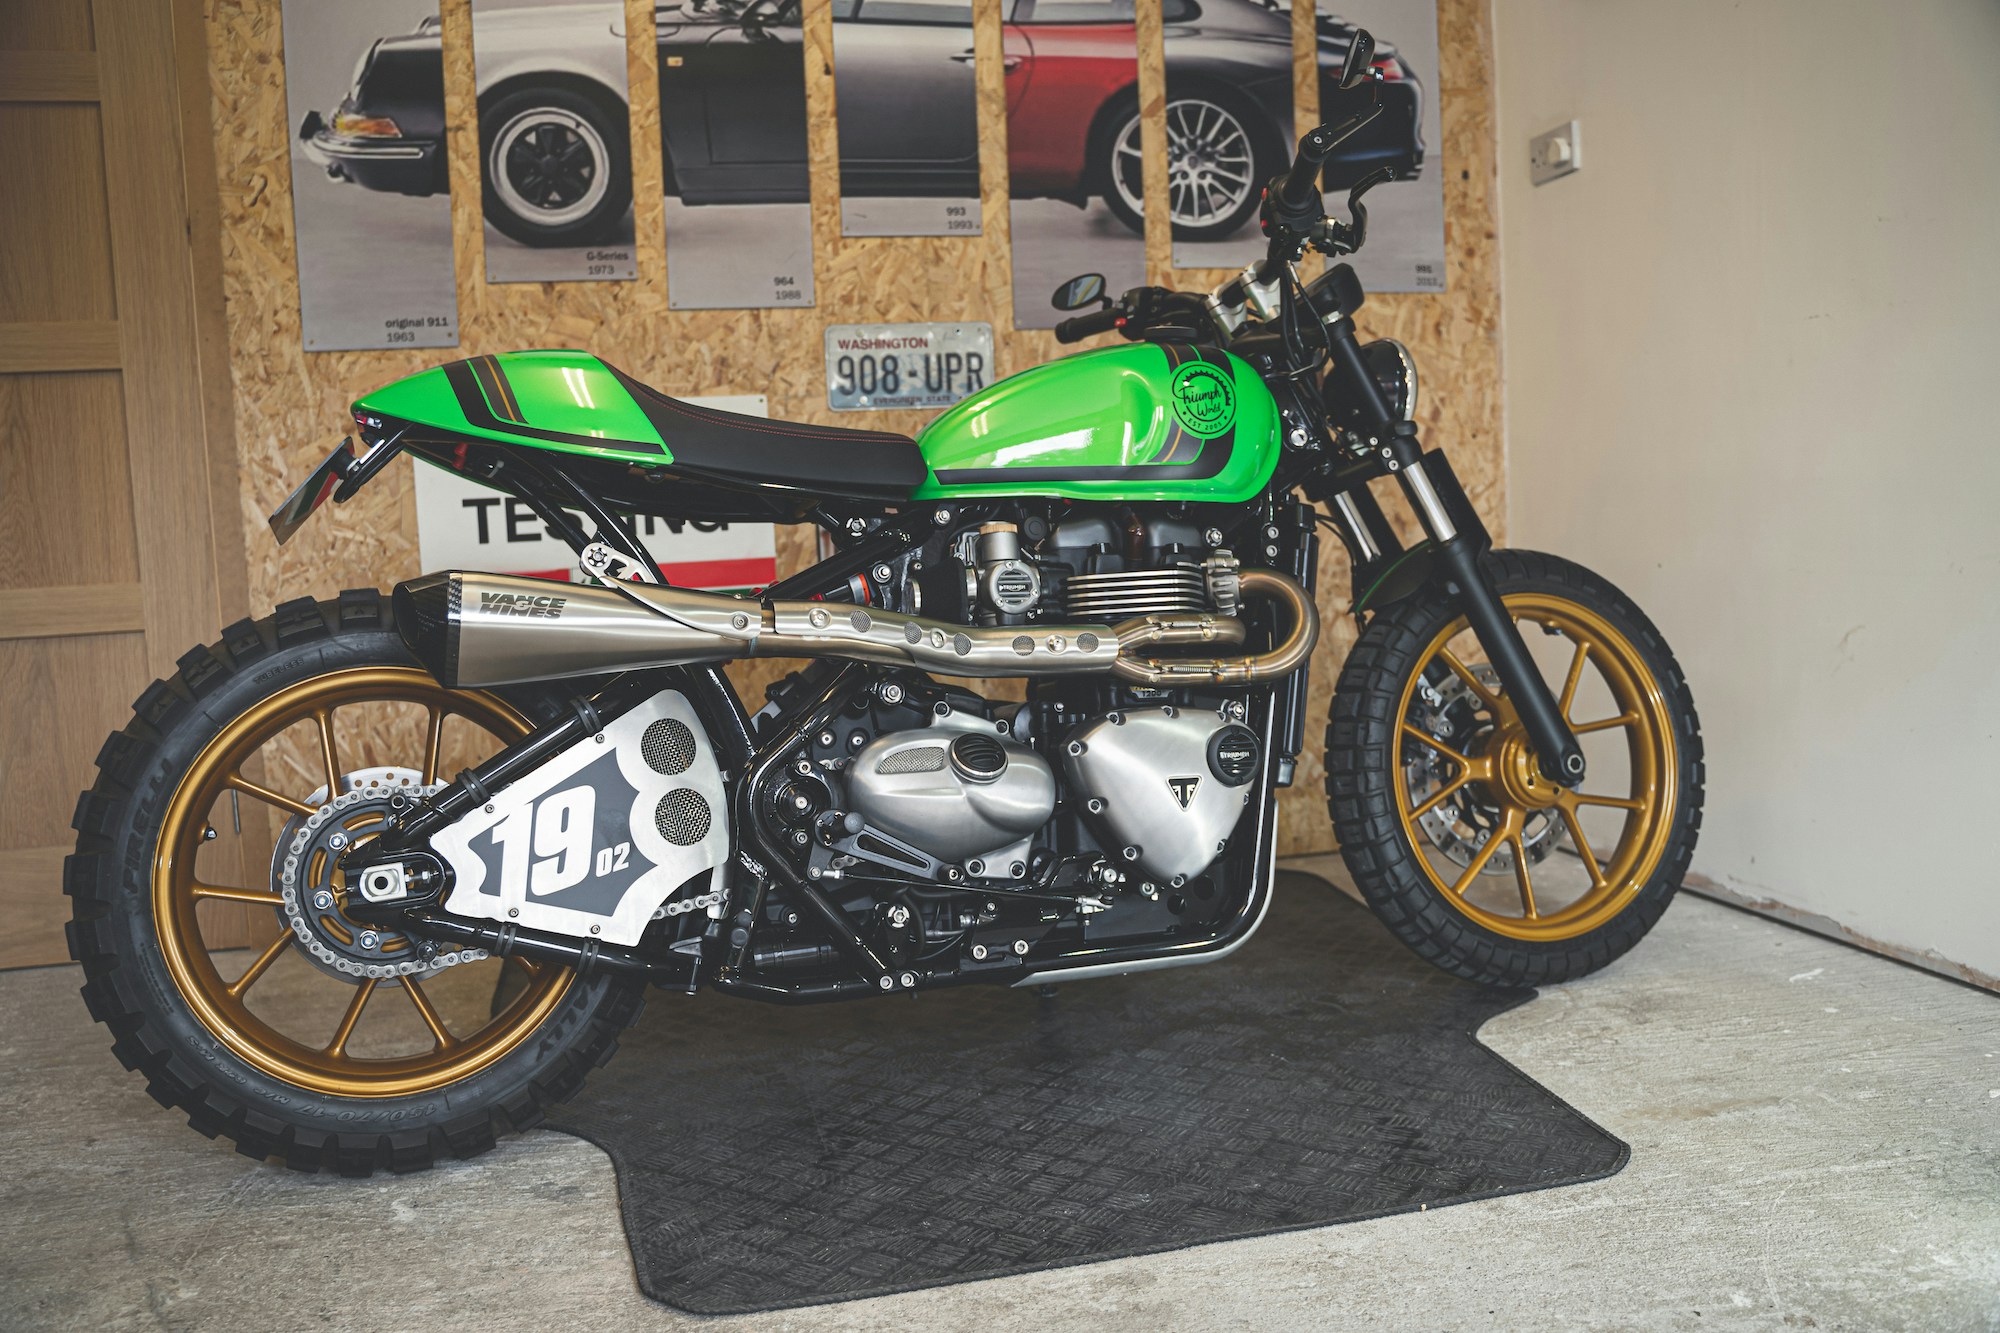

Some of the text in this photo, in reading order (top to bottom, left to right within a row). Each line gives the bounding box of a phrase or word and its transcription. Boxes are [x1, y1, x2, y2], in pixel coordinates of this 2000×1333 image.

[946, 206, 966, 217] 993
[948, 220, 973, 230] 1993
[586, 251, 629, 261] G-Series
[588, 265, 615, 275] 1973
[773, 276, 794, 287] 964
[776, 290, 802, 300] 1988
[385, 316, 449, 330] original 911
[387, 332, 415, 343] 1963
[838, 336, 929, 351] WASHINGTON
[1178, 383, 1222, 406] Triumph
[481, 592, 567, 609] VANCE
[479, 603, 563, 620] HINES
[253, 656, 304, 684] TUBELESS
[122, 757, 174, 895] PIRELLI
[491, 784, 631, 902] 19 02
